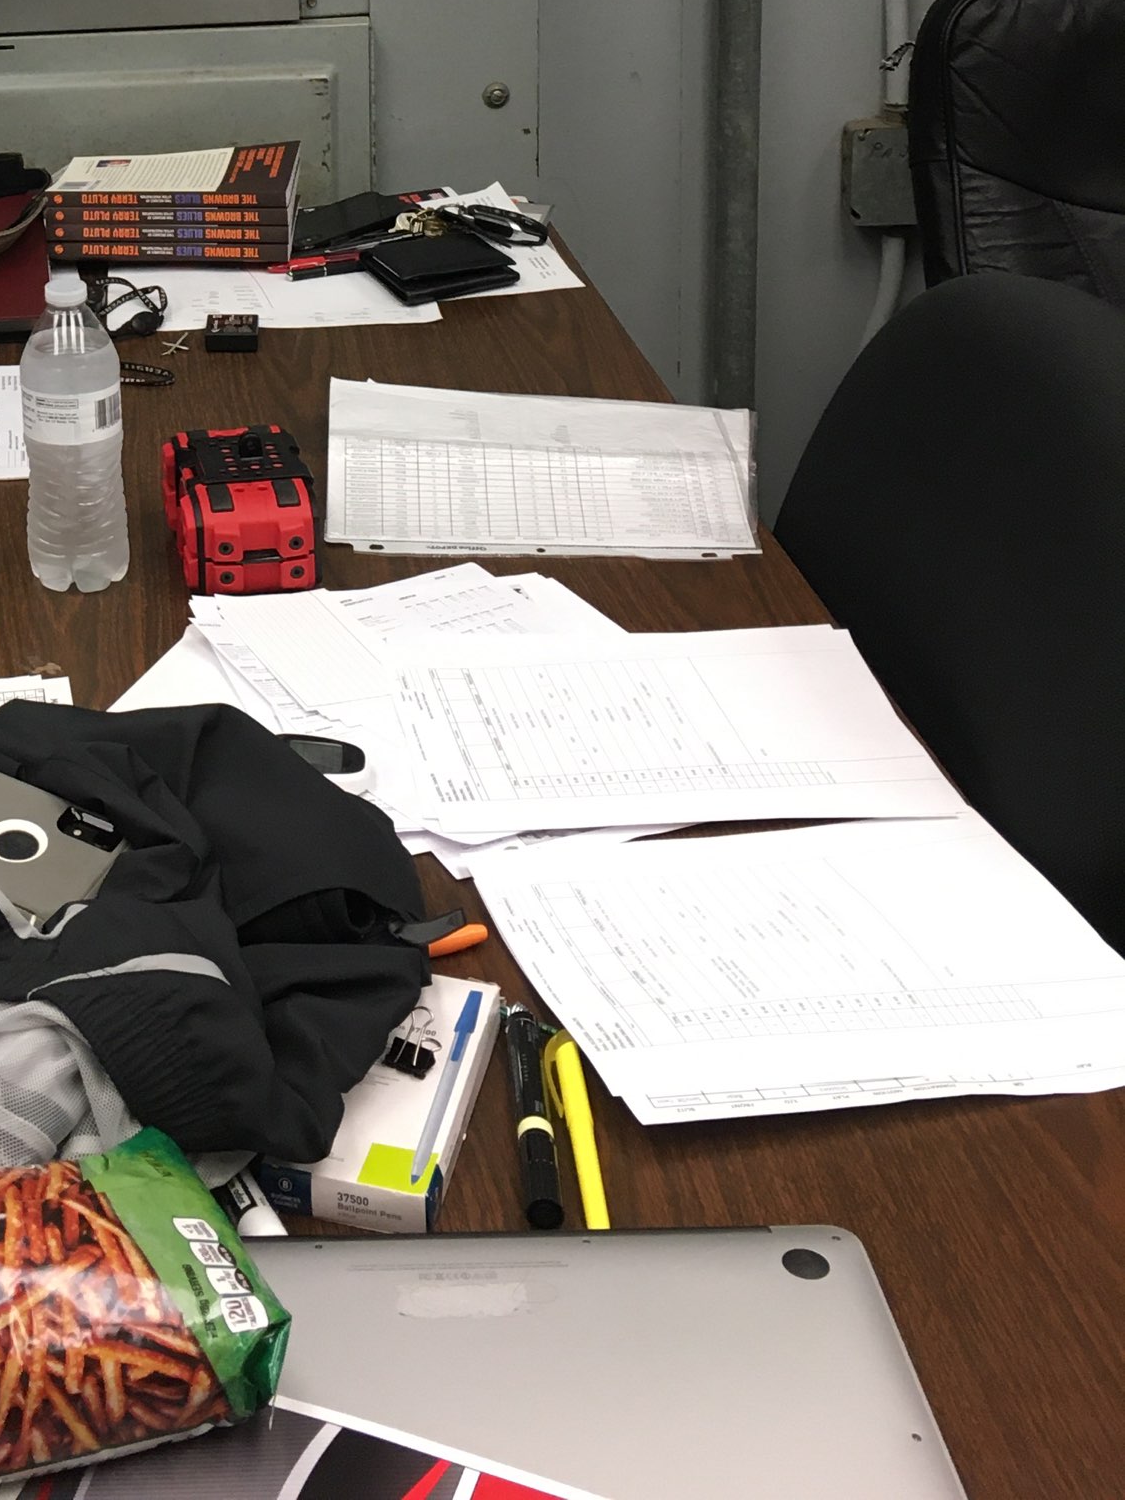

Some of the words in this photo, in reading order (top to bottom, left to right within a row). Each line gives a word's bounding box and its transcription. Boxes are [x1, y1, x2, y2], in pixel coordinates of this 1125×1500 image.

[81, 193, 109, 204] PLUTO
[111, 194, 139, 204] TERRY
[175, 194, 201, 204] BLUES
[202, 194, 240, 205] BROWNS
[241, 194, 258, 205] THE
[83, 210, 110, 221] PLUTO
[112, 210, 140, 221] TERRY
[176, 211, 203, 222] BLUES
[204, 211, 242, 222] BROWNS
[243, 211, 260, 222] THE
[83, 227, 110, 238] PLUTO
[112, 228, 141, 238] TERRY
[177, 228, 203, 239] BLUES
[205, 228, 243, 239] BROWNS
[243, 229, 261, 240] THE
[82, 244, 110, 255] PLUTO
[111, 245, 140, 256] TERRY
[176, 246, 203, 257] BLUES
[203, 246, 241, 257] BROWNS
[242, 247, 259, 258] THE
[336, 1191, 369, 1207] 37500
[336, 1202, 378, 1218] Ballpoint
[379, 1210, 403, 1221] Pens
[182, 1264, 205, 1298] SERVING
[225, 1300, 249, 1327] 120
